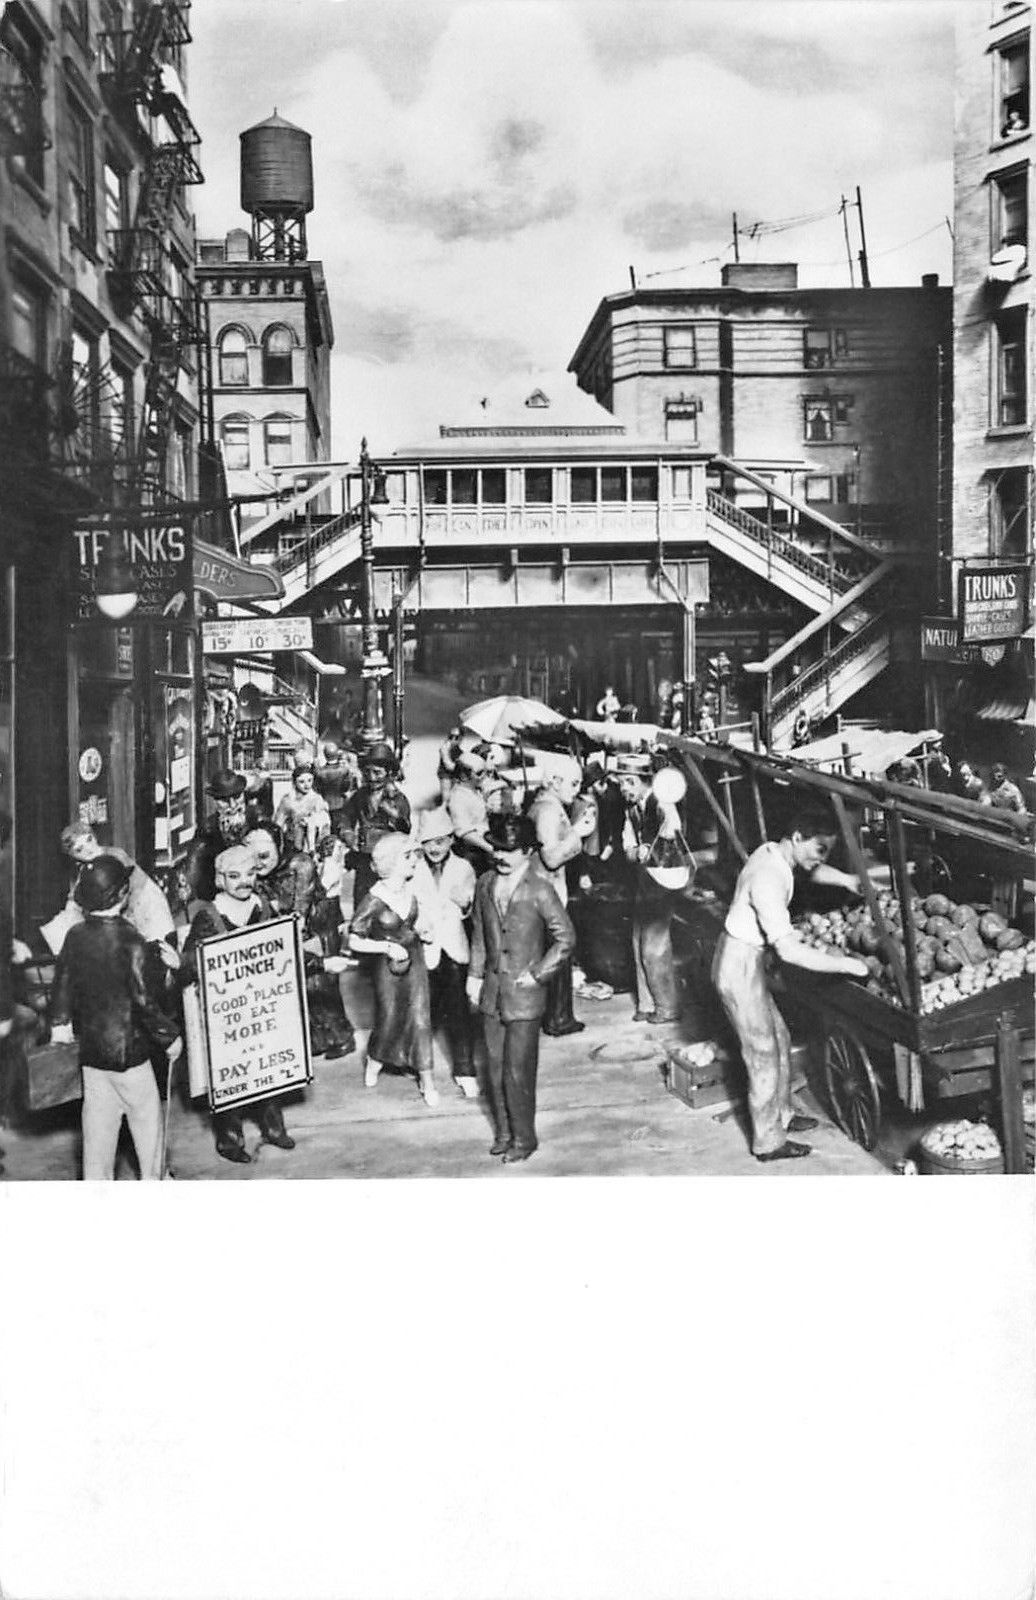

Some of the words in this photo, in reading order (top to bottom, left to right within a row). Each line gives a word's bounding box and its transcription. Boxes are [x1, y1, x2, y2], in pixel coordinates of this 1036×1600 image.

[964, 574, 1017, 601] TRUNKS
[206, 937, 285, 972] RIVINGTON
[224, 957, 276, 984] LUNCH
[211, 994, 248, 1015] GOOD
[254, 981, 294, 1002] PLACE
[245, 982, 254, 990] A
[224, 1012, 242, 1027] TO
[250, 1001, 278, 1019] EAT
[224, 1018, 278, 1044] MORE
[219, 1060, 252, 1082] PAY
[258, 1049, 296, 1071] LESS
[214, 1082, 249, 1099] UNDER
[253, 1075, 275, 1090] THE
